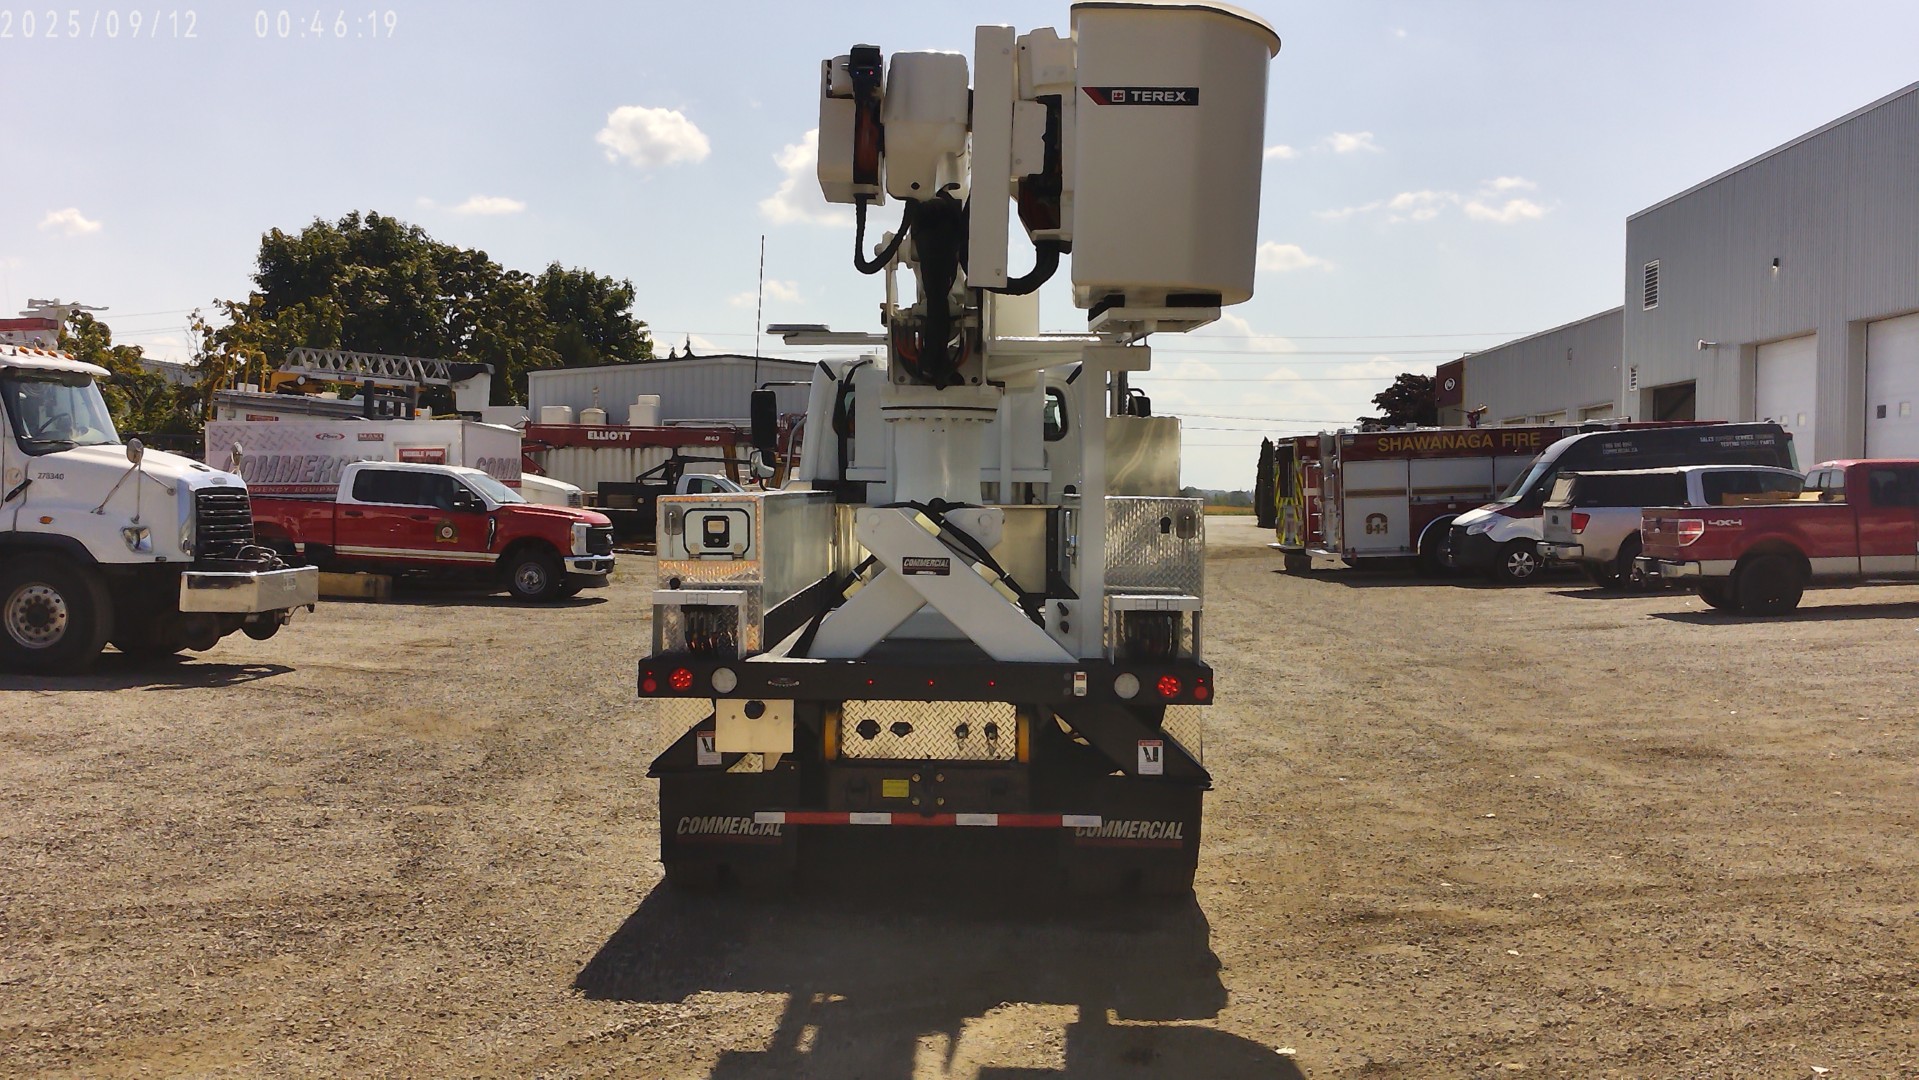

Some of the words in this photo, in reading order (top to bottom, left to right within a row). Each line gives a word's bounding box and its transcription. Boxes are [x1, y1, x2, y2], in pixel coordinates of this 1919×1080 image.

[1131, 90, 1187, 102] TEREX
[587, 431, 632, 441] ELLIOTT
[1377, 433, 1495, 452] SHAWANAGA
[1502, 432, 1541, 447] FIRE
[1366, 525, 1388, 535] 9-1-1
[903, 558, 949, 568] COMMERCIAL
[676, 816, 783, 837] COMMERCIAL
